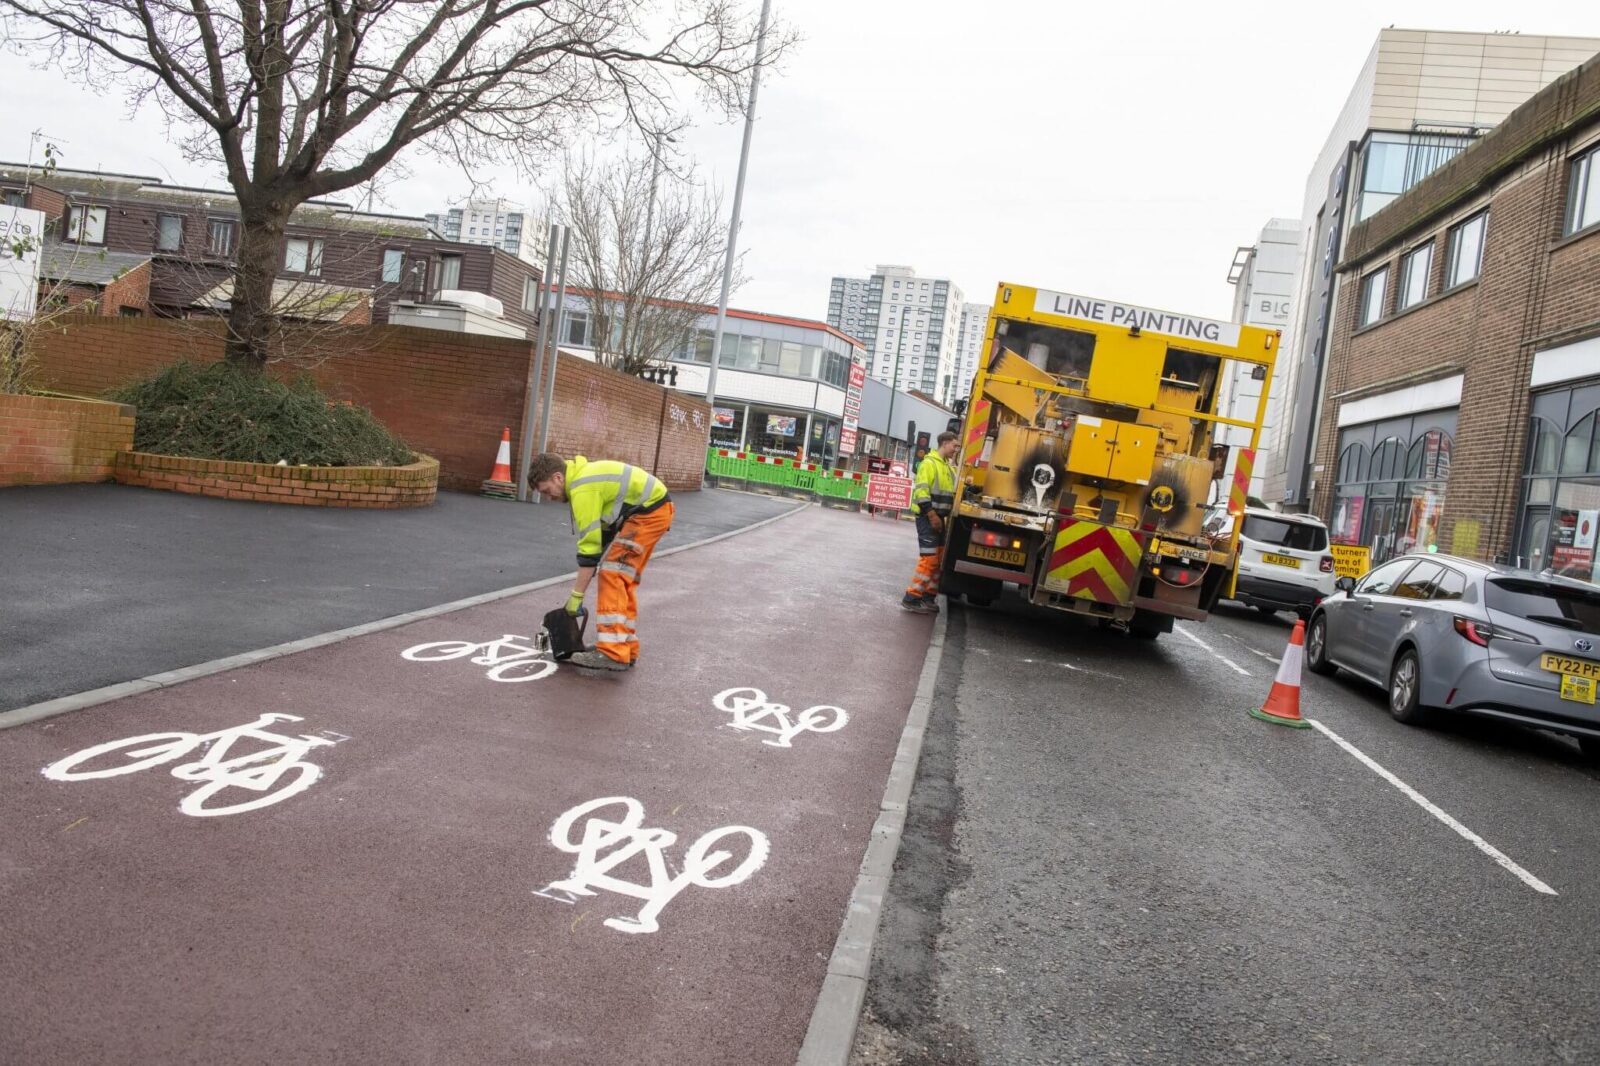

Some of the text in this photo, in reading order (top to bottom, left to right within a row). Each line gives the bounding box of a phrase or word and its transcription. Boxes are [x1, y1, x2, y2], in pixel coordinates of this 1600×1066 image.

[1054, 296, 1220, 341] LINE PAINTING
[889, 486, 905, 494] HERE
[1180, 549, 1204, 559] ANCE
[1336, 548, 1368, 557] turners
[1334, 558, 1350, 566] are
[1335, 565, 1360, 576] oming
[1546, 656, 1600, 677] FY22 PF
